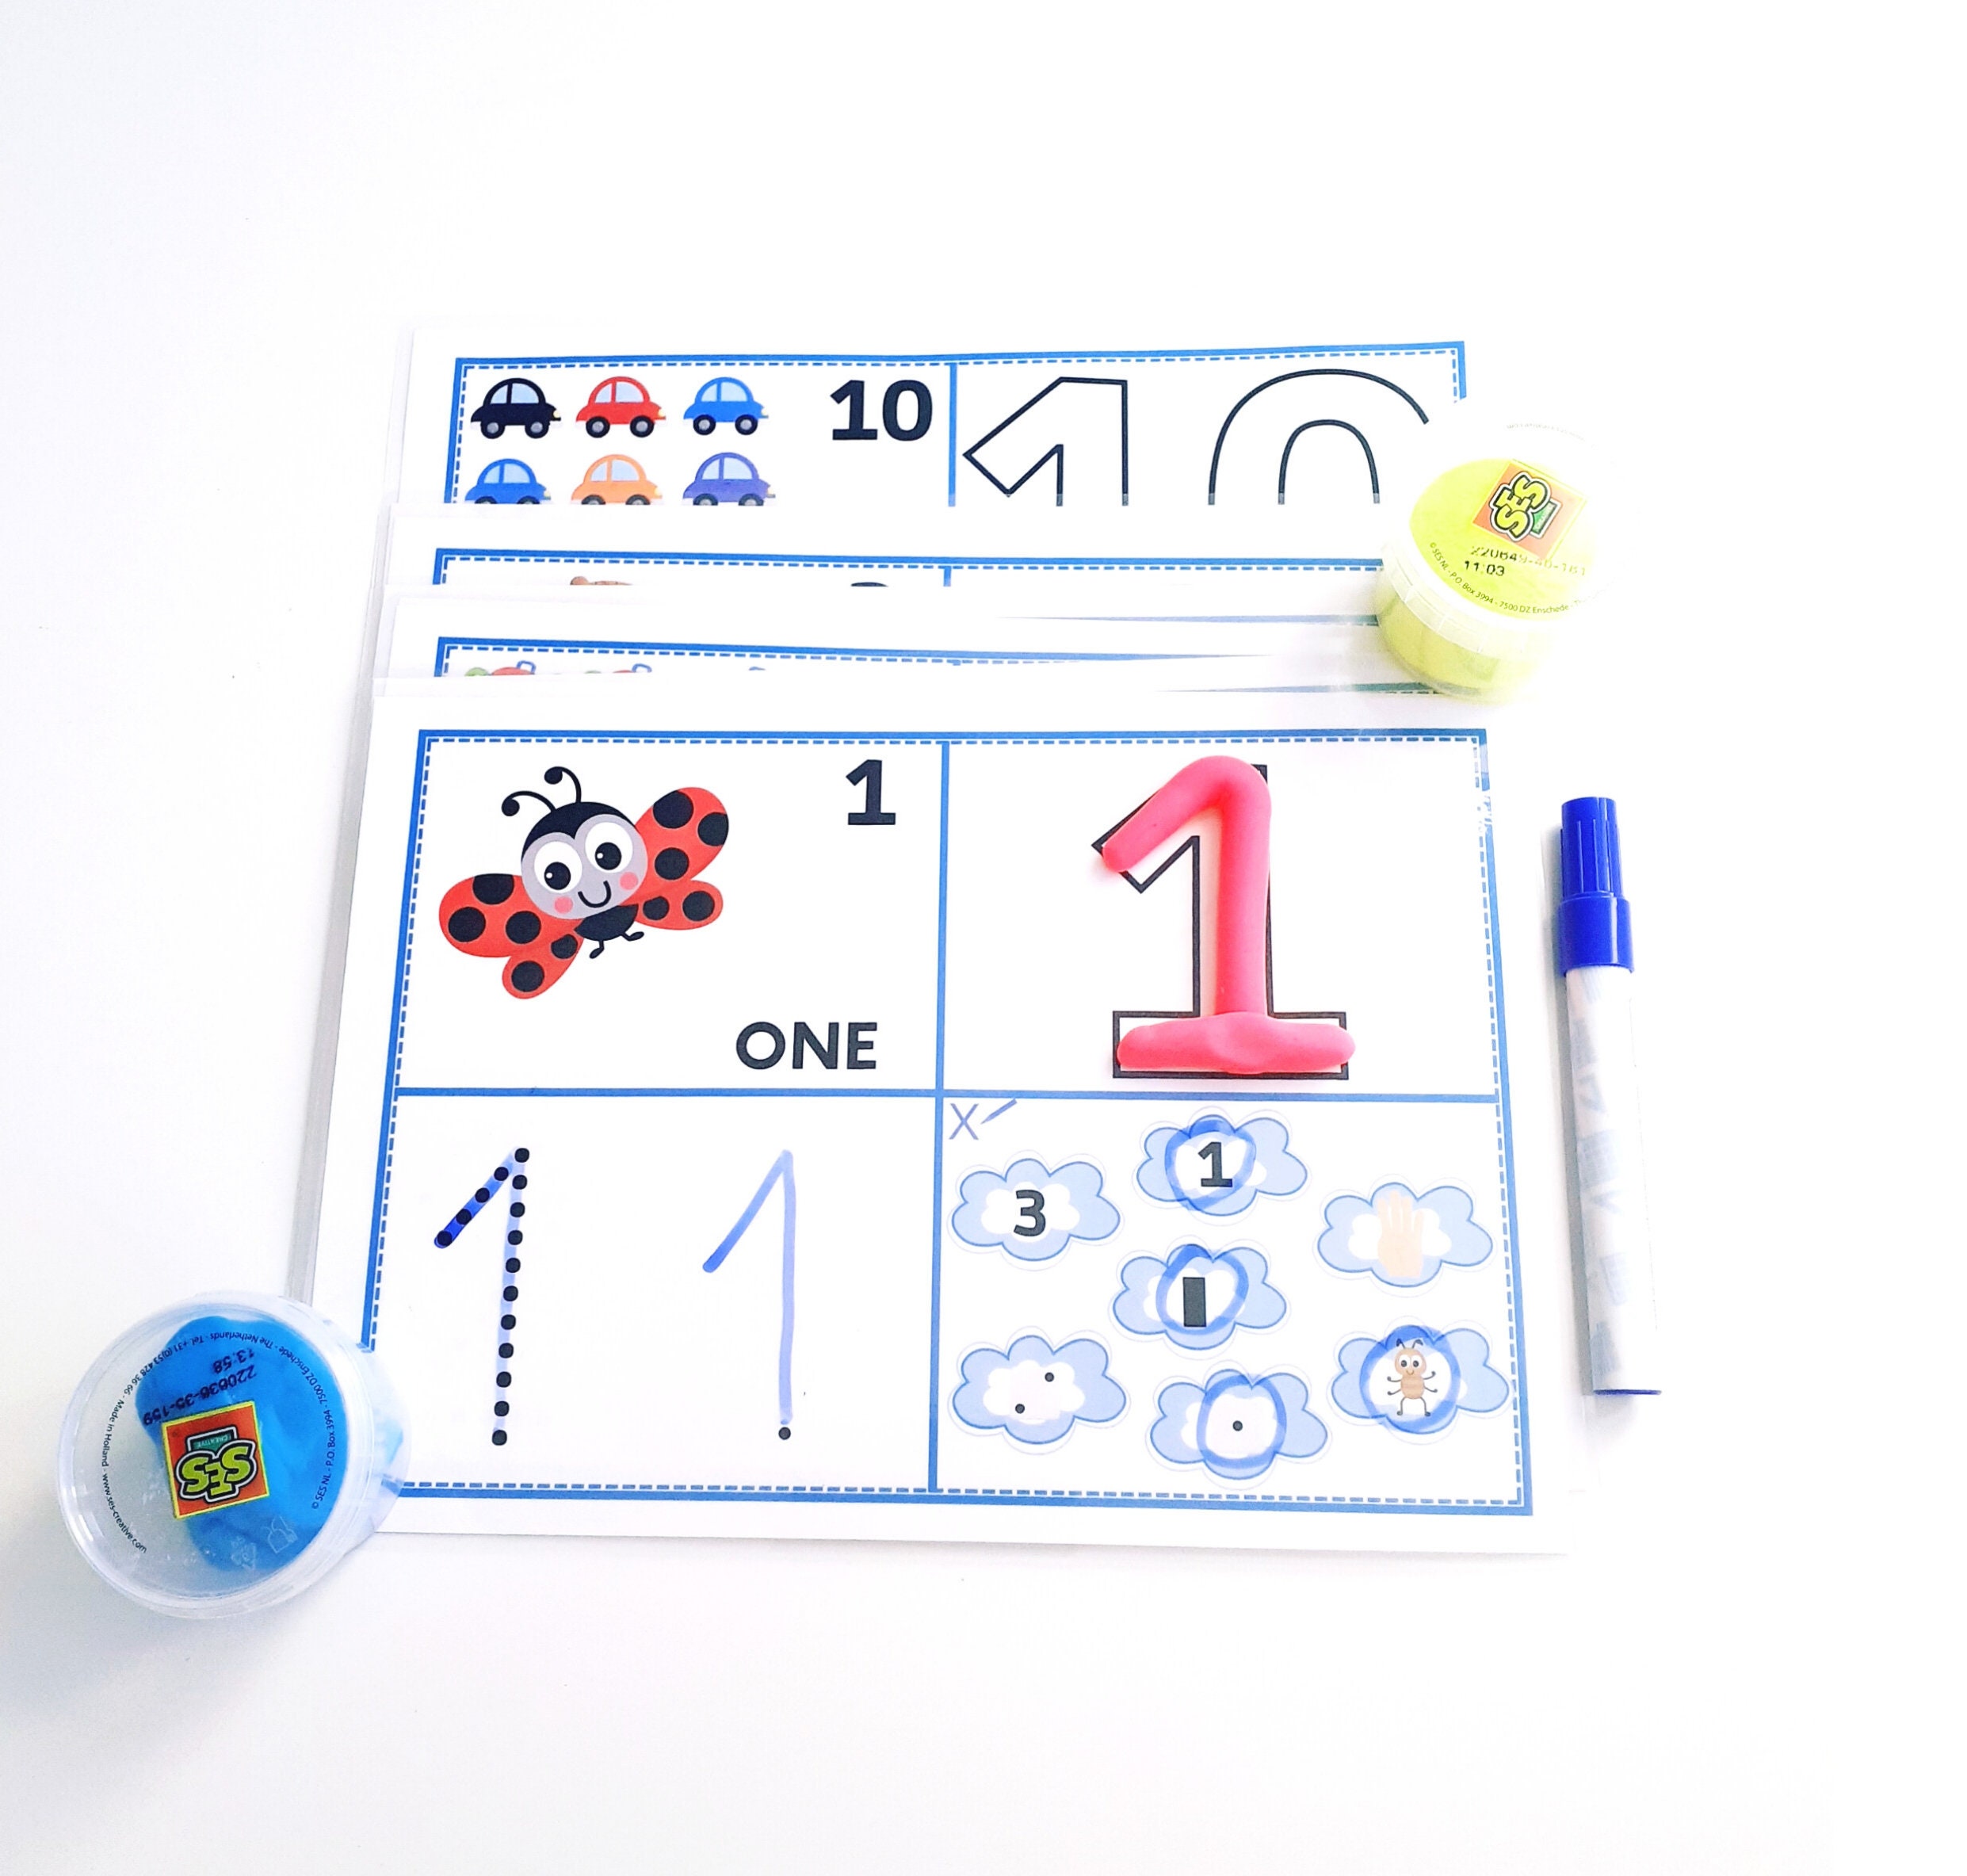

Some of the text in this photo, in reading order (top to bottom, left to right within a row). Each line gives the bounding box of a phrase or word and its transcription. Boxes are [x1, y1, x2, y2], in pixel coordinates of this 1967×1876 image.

[831, 380, 932, 441] 10
[1493, 474, 1548, 539] SES
[1462, 583, 1476, 595] Box
[1475, 592, 1494, 604] 3994
[1499, 601, 1518, 612] 7500
[1519, 605, 1531, 613] DZ
[1533, 604, 1569, 613] Enschede
[846, 760, 896, 826] 1
[736, 1022, 877, 1070] ONE
[1198, 1142, 1233, 1187] 1
[1014, 1190, 1046, 1237] 3
[210, 1332, 259, 1343] Netherlands
[259, 1339, 273, 1349] The
[140, 1362, 154, 1376] 428
[278, 1346, 310, 1375] Enschede
[124, 1385, 133, 1395] 66
[132, 1374, 142, 1385] 36
[305, 1372, 318, 1385] DZ
[314, 1385, 327, 1404] 7500
[109, 1399, 124, 1422] Made
[323, 1409, 334, 1430] 3994
[101, 1434, 112, 1466] Holland
[179, 1442, 254, 1498] SES
[321, 1473, 331, 1484] NL
[315, 1485, 327, 1501] SES
